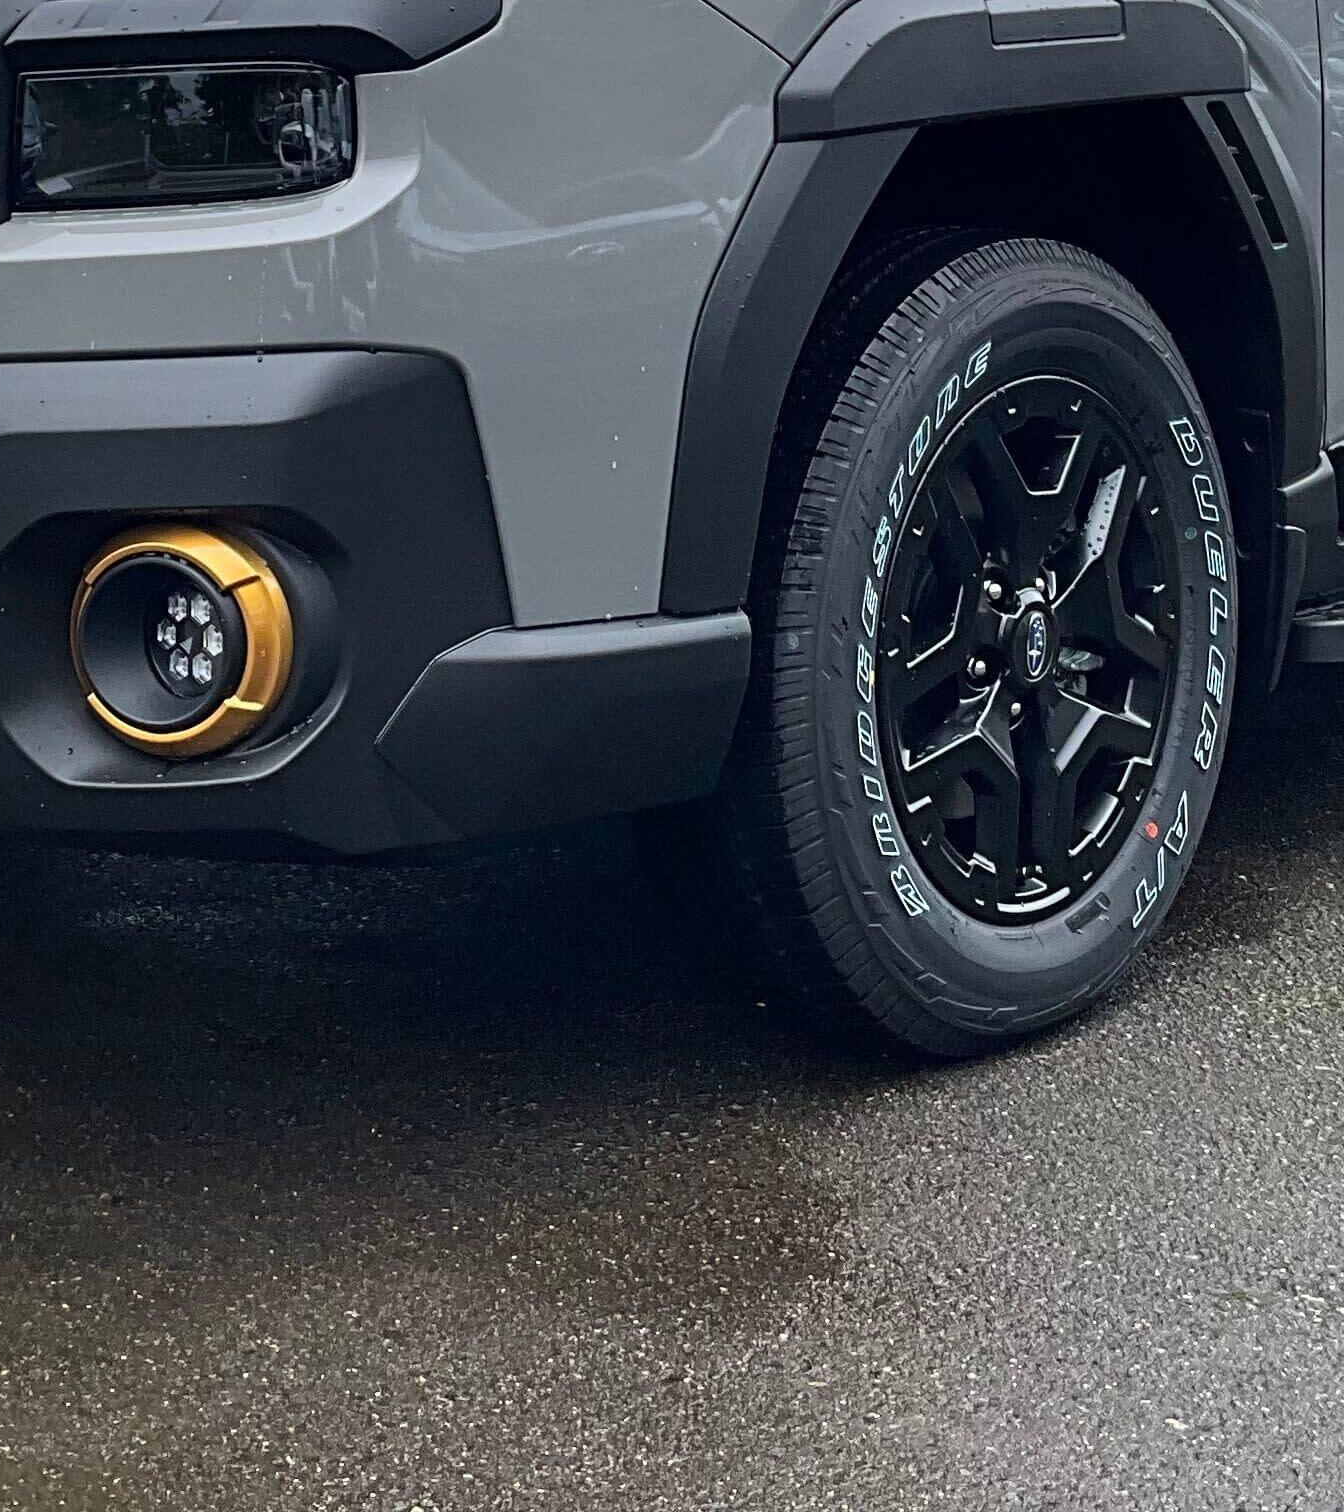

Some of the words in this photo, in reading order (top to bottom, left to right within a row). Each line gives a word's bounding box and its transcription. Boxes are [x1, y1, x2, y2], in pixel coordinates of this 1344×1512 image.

[856, 341, 992, 917] BRIDGESTONE
[1169, 416, 1228, 771] DUELER
[1132, 790, 1189, 928] A/T
